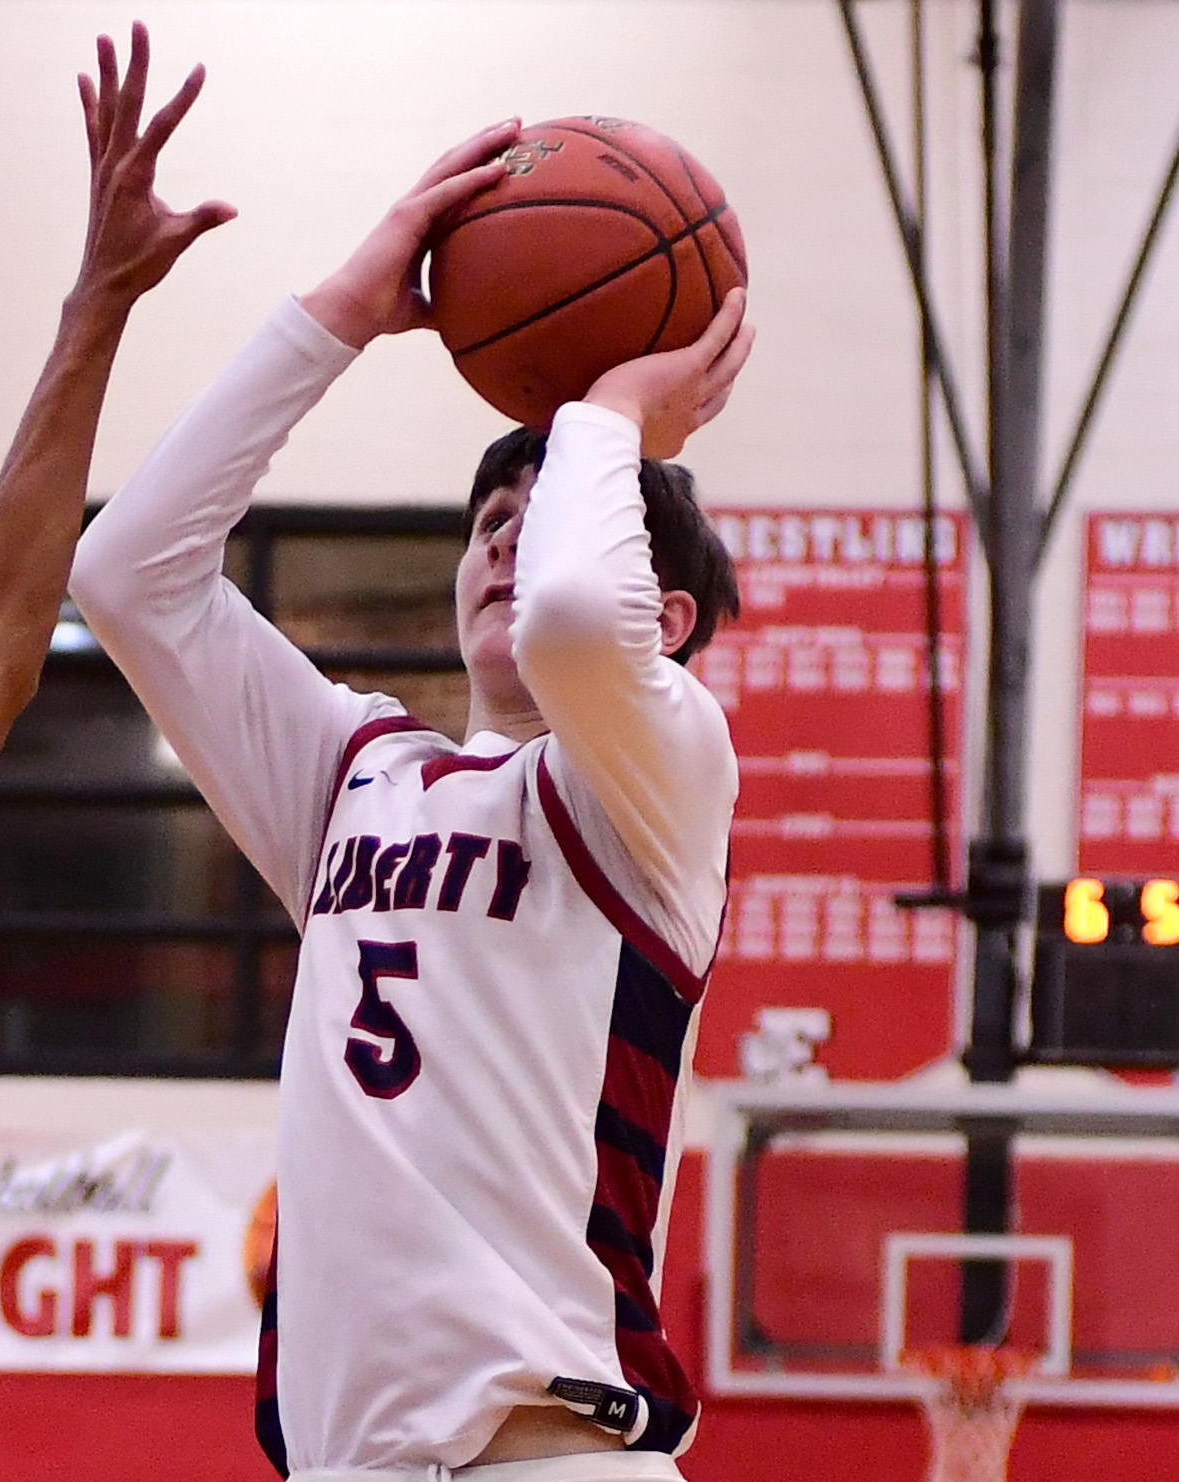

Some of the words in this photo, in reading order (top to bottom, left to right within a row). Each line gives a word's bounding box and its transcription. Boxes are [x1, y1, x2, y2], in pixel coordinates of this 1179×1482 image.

[709, 514, 957, 563] RESTLING
[312, 832, 532, 922] LIBERTY
[344, 939, 422, 1100] 5
[608, 1401, 627, 1419] M
